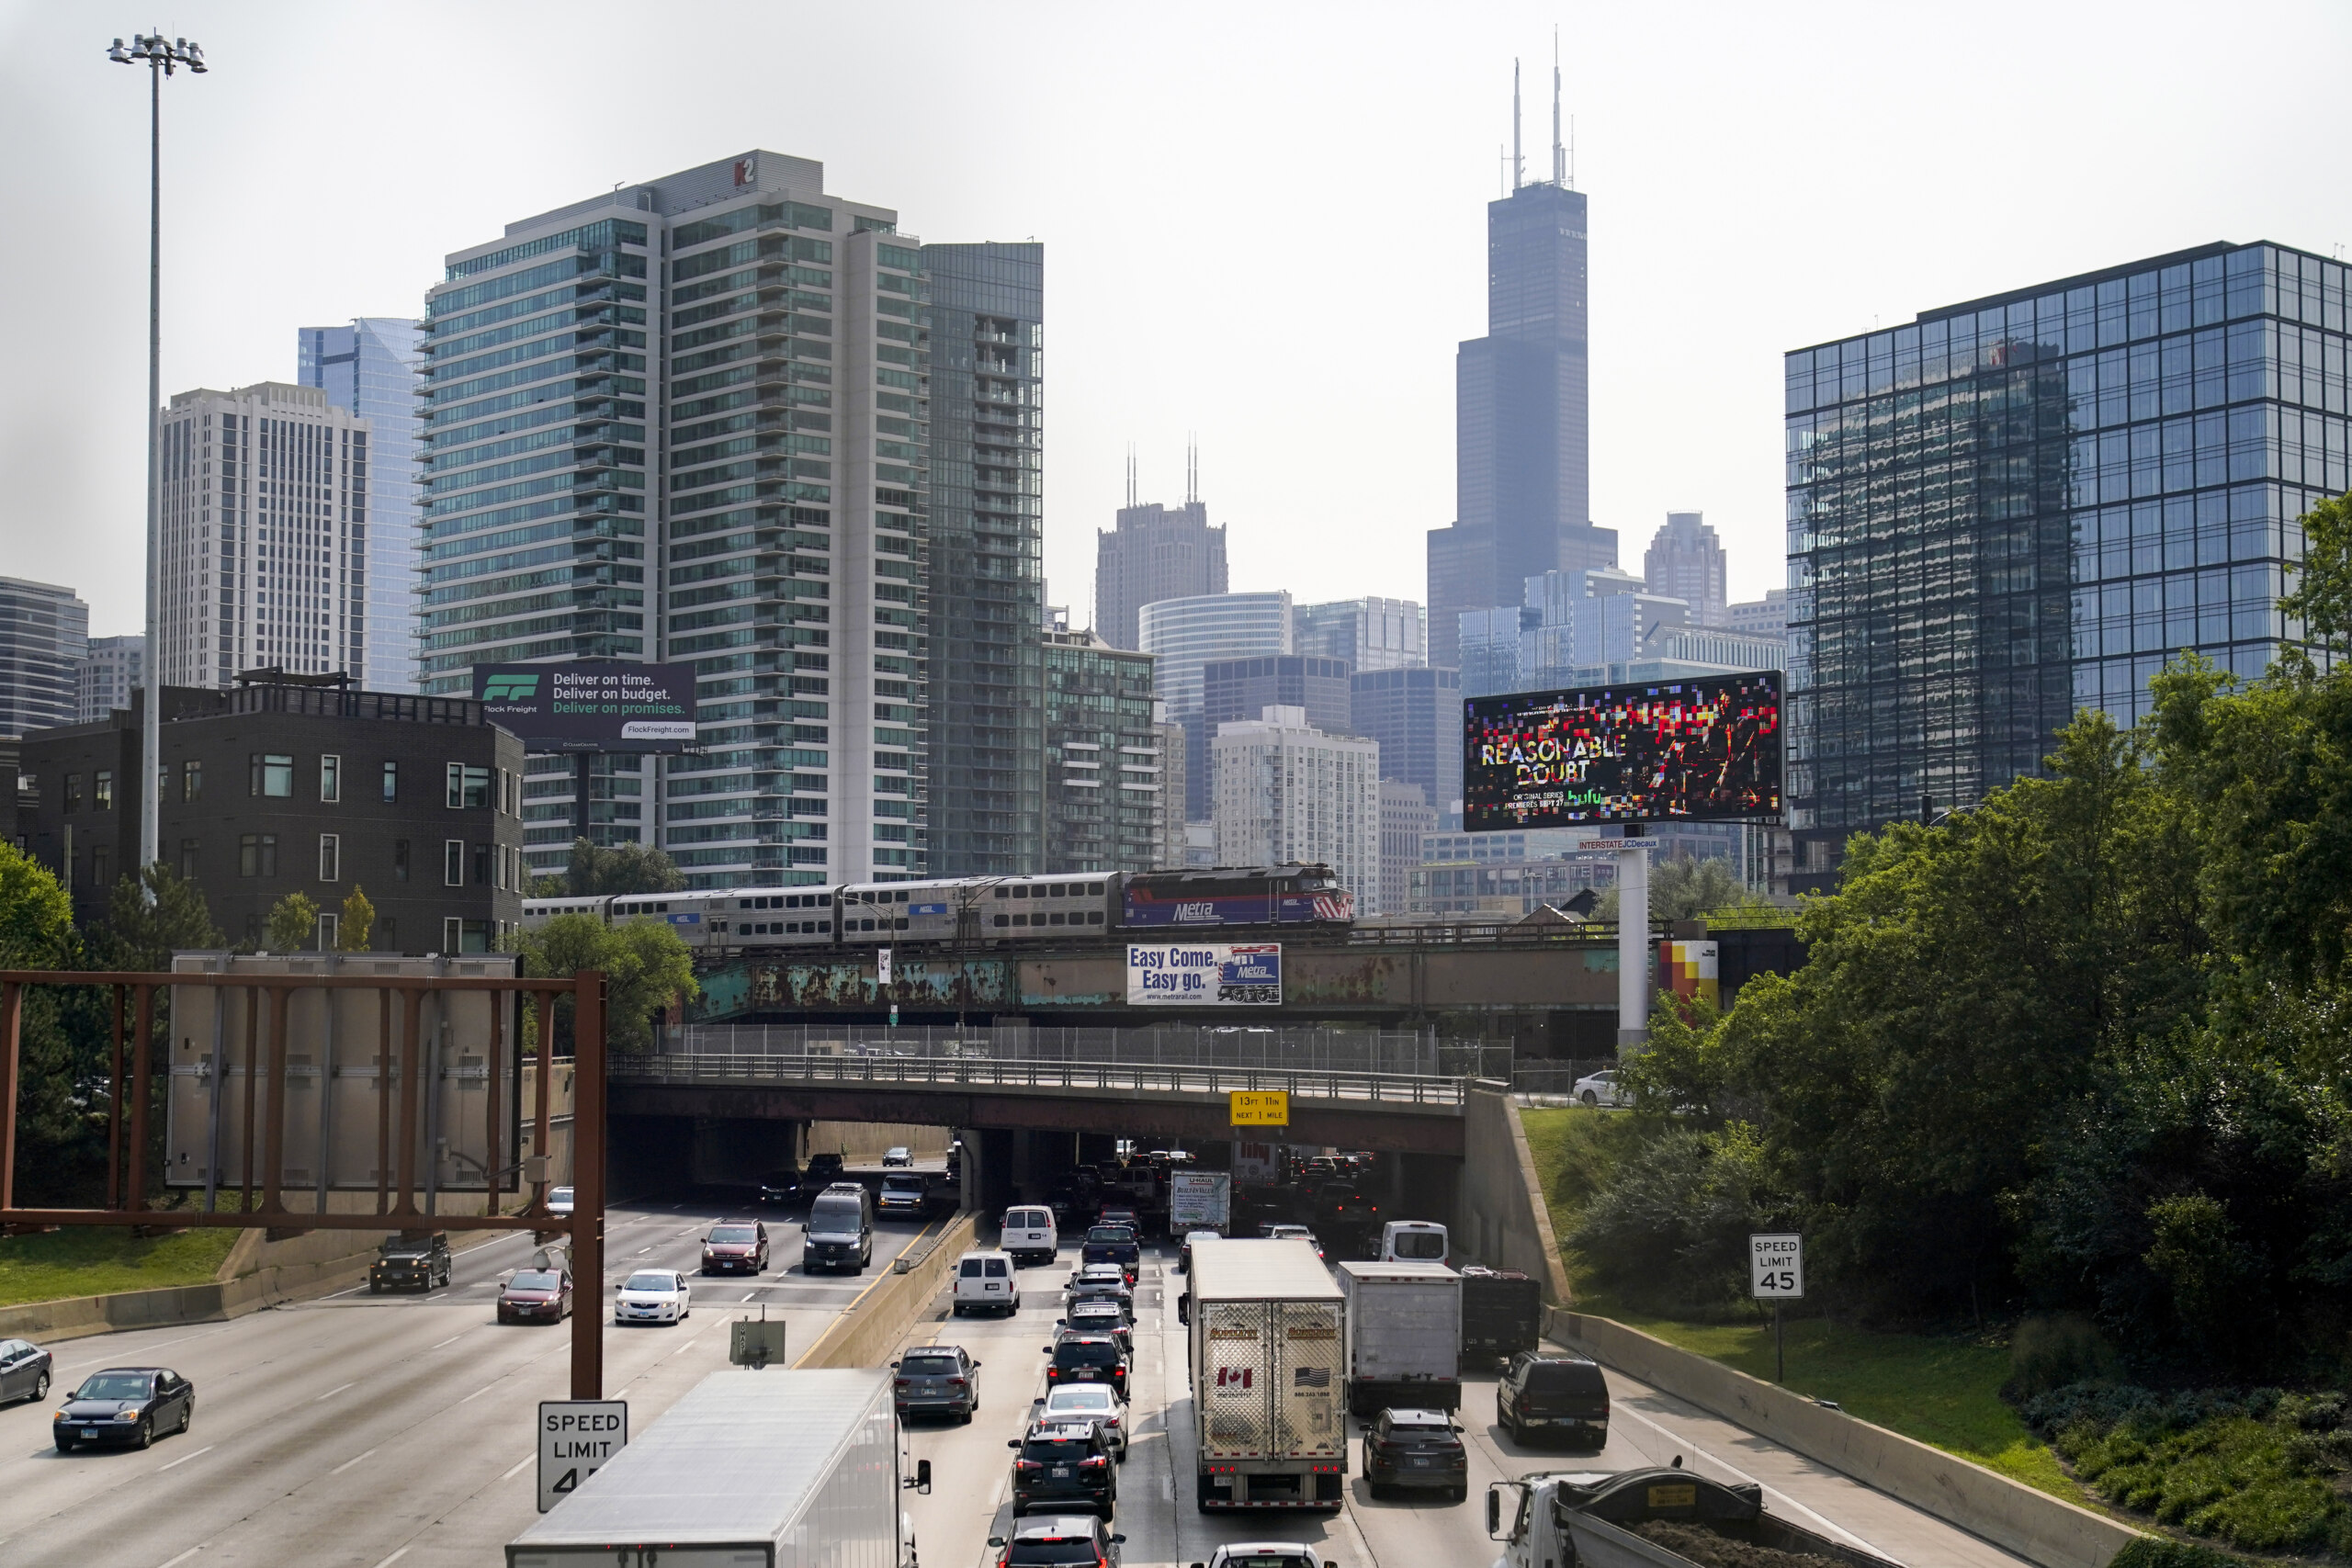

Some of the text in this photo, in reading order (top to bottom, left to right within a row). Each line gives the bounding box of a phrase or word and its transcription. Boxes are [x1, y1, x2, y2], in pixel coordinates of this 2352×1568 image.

[734, 158, 754, 186] K2
[553, 673, 654, 685] Deliver on time.
[553, 687, 671, 703] Deliver on budget.
[507, 705, 537, 714] Freight
[553, 702, 685, 716] Deliver on promises.
[628, 726, 689, 734] FlockFreight.com
[1481, 734, 1627, 766] REASONABLE
[1516, 760, 1590, 785] DOUBT
[1543, 791, 1564, 799] SERIES
[1567, 789, 1601, 805] hulu
[1172, 902, 1214, 921] Metra
[1130, 948, 1218, 969] Easy Come.
[1143, 970, 1206, 991] Easy go.
[1237, 966, 1268, 979] Metra
[1259, 1111, 1262, 1120] 1
[1755, 1242, 1797, 1252] SPEED
[1759, 1257, 1792, 1267] LIMIT
[1760, 1271, 1794, 1291] 45
[547, 1415, 620, 1431] SPEED
[554, 1441, 611, 1459] LIMIT
[552, 1468, 600, 1493] 4
